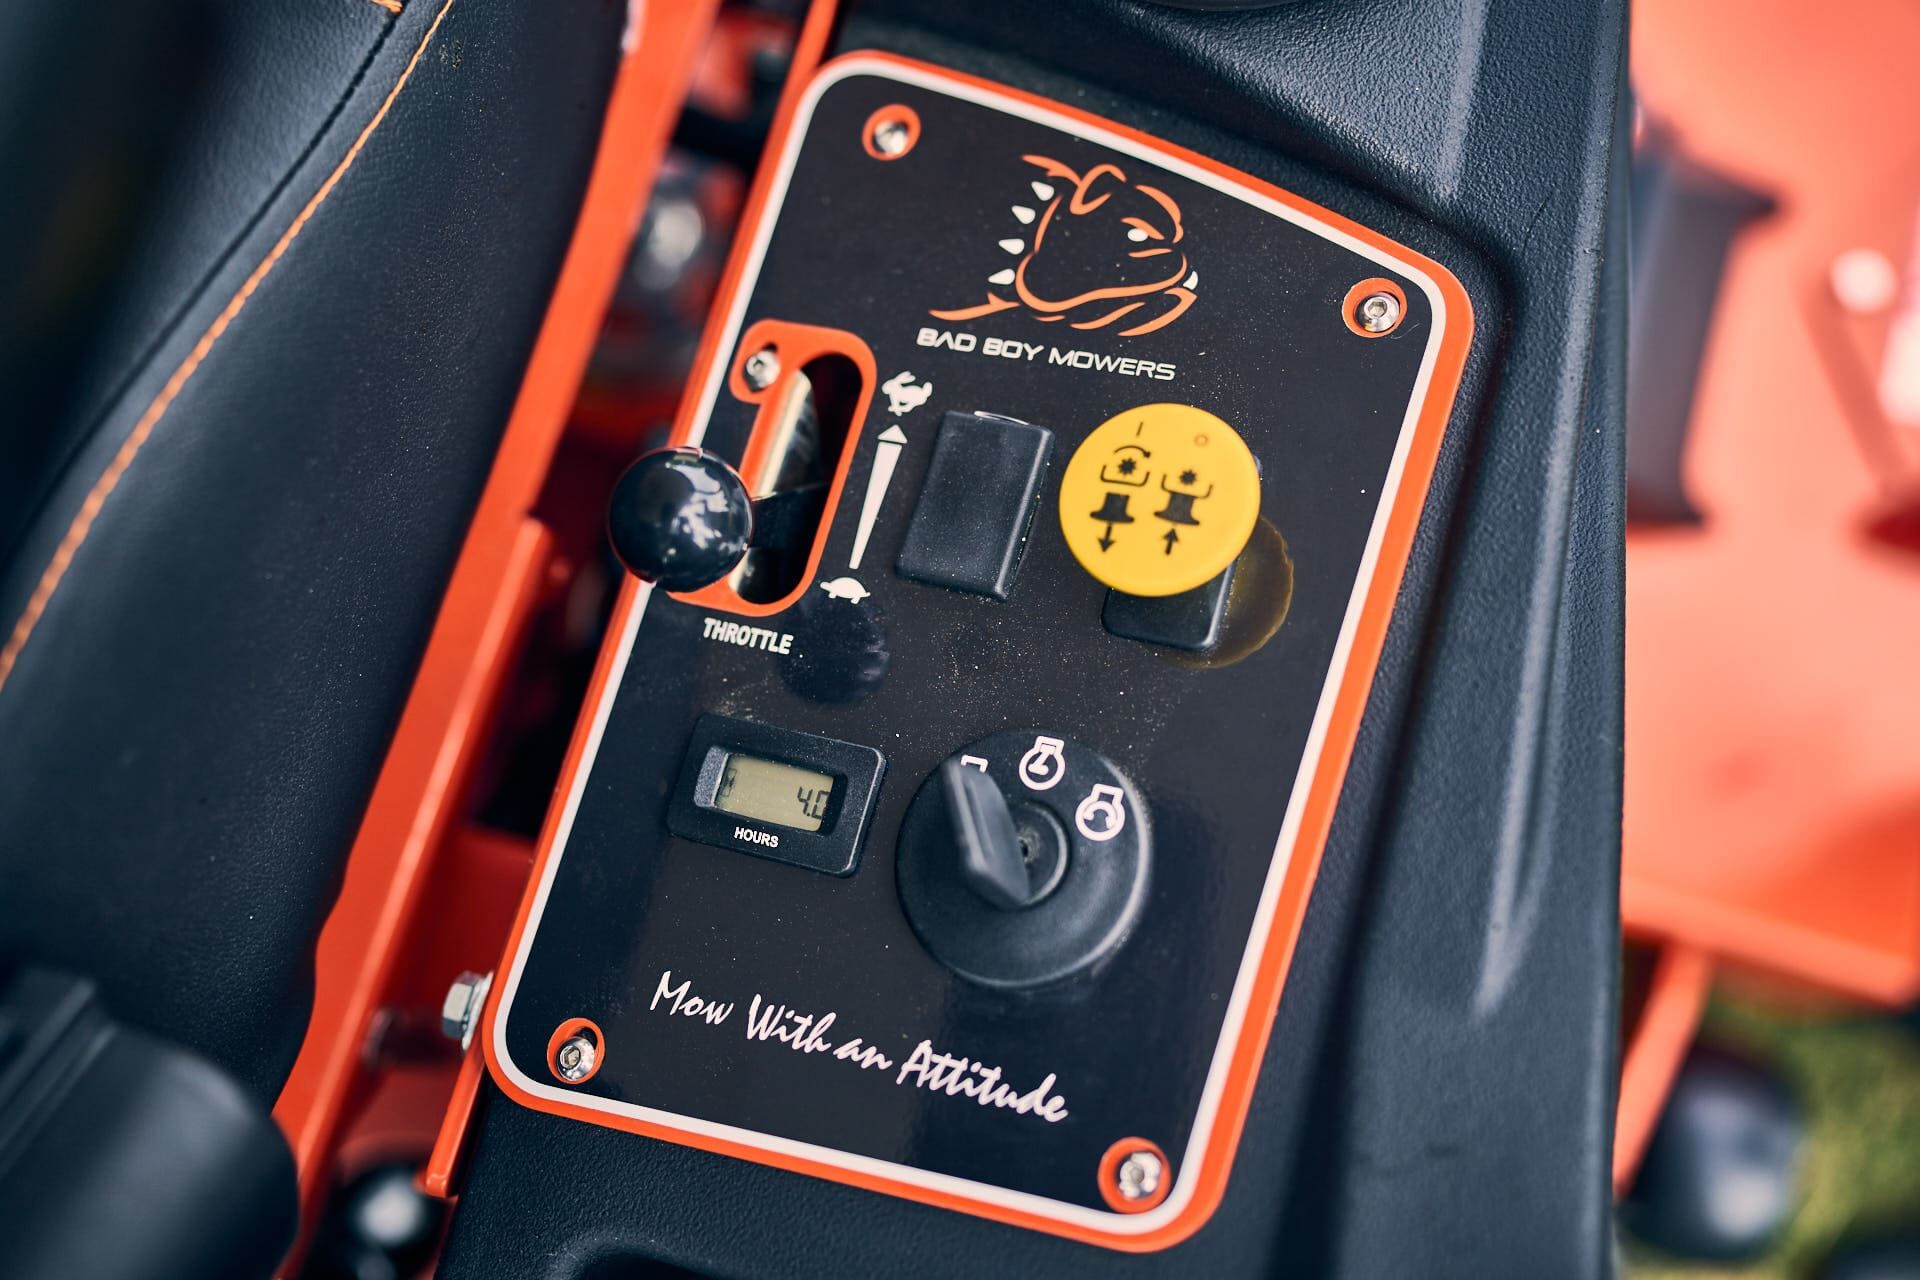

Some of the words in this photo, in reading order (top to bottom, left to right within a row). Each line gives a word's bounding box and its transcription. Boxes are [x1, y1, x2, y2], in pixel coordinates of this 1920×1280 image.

[916, 327, 976, 352] BAD
[982, 337, 1044, 361] BOY
[1048, 347, 1176, 381] MOWERS
[702, 617, 794, 655] THROTTLE
[734, 826, 779, 848] HOURS
[649, 970, 734, 1026] Mow
[746, 993, 837, 1054] With
[833, 1037, 893, 1071] an
[896, 1039, 1069, 1124] Attitude
